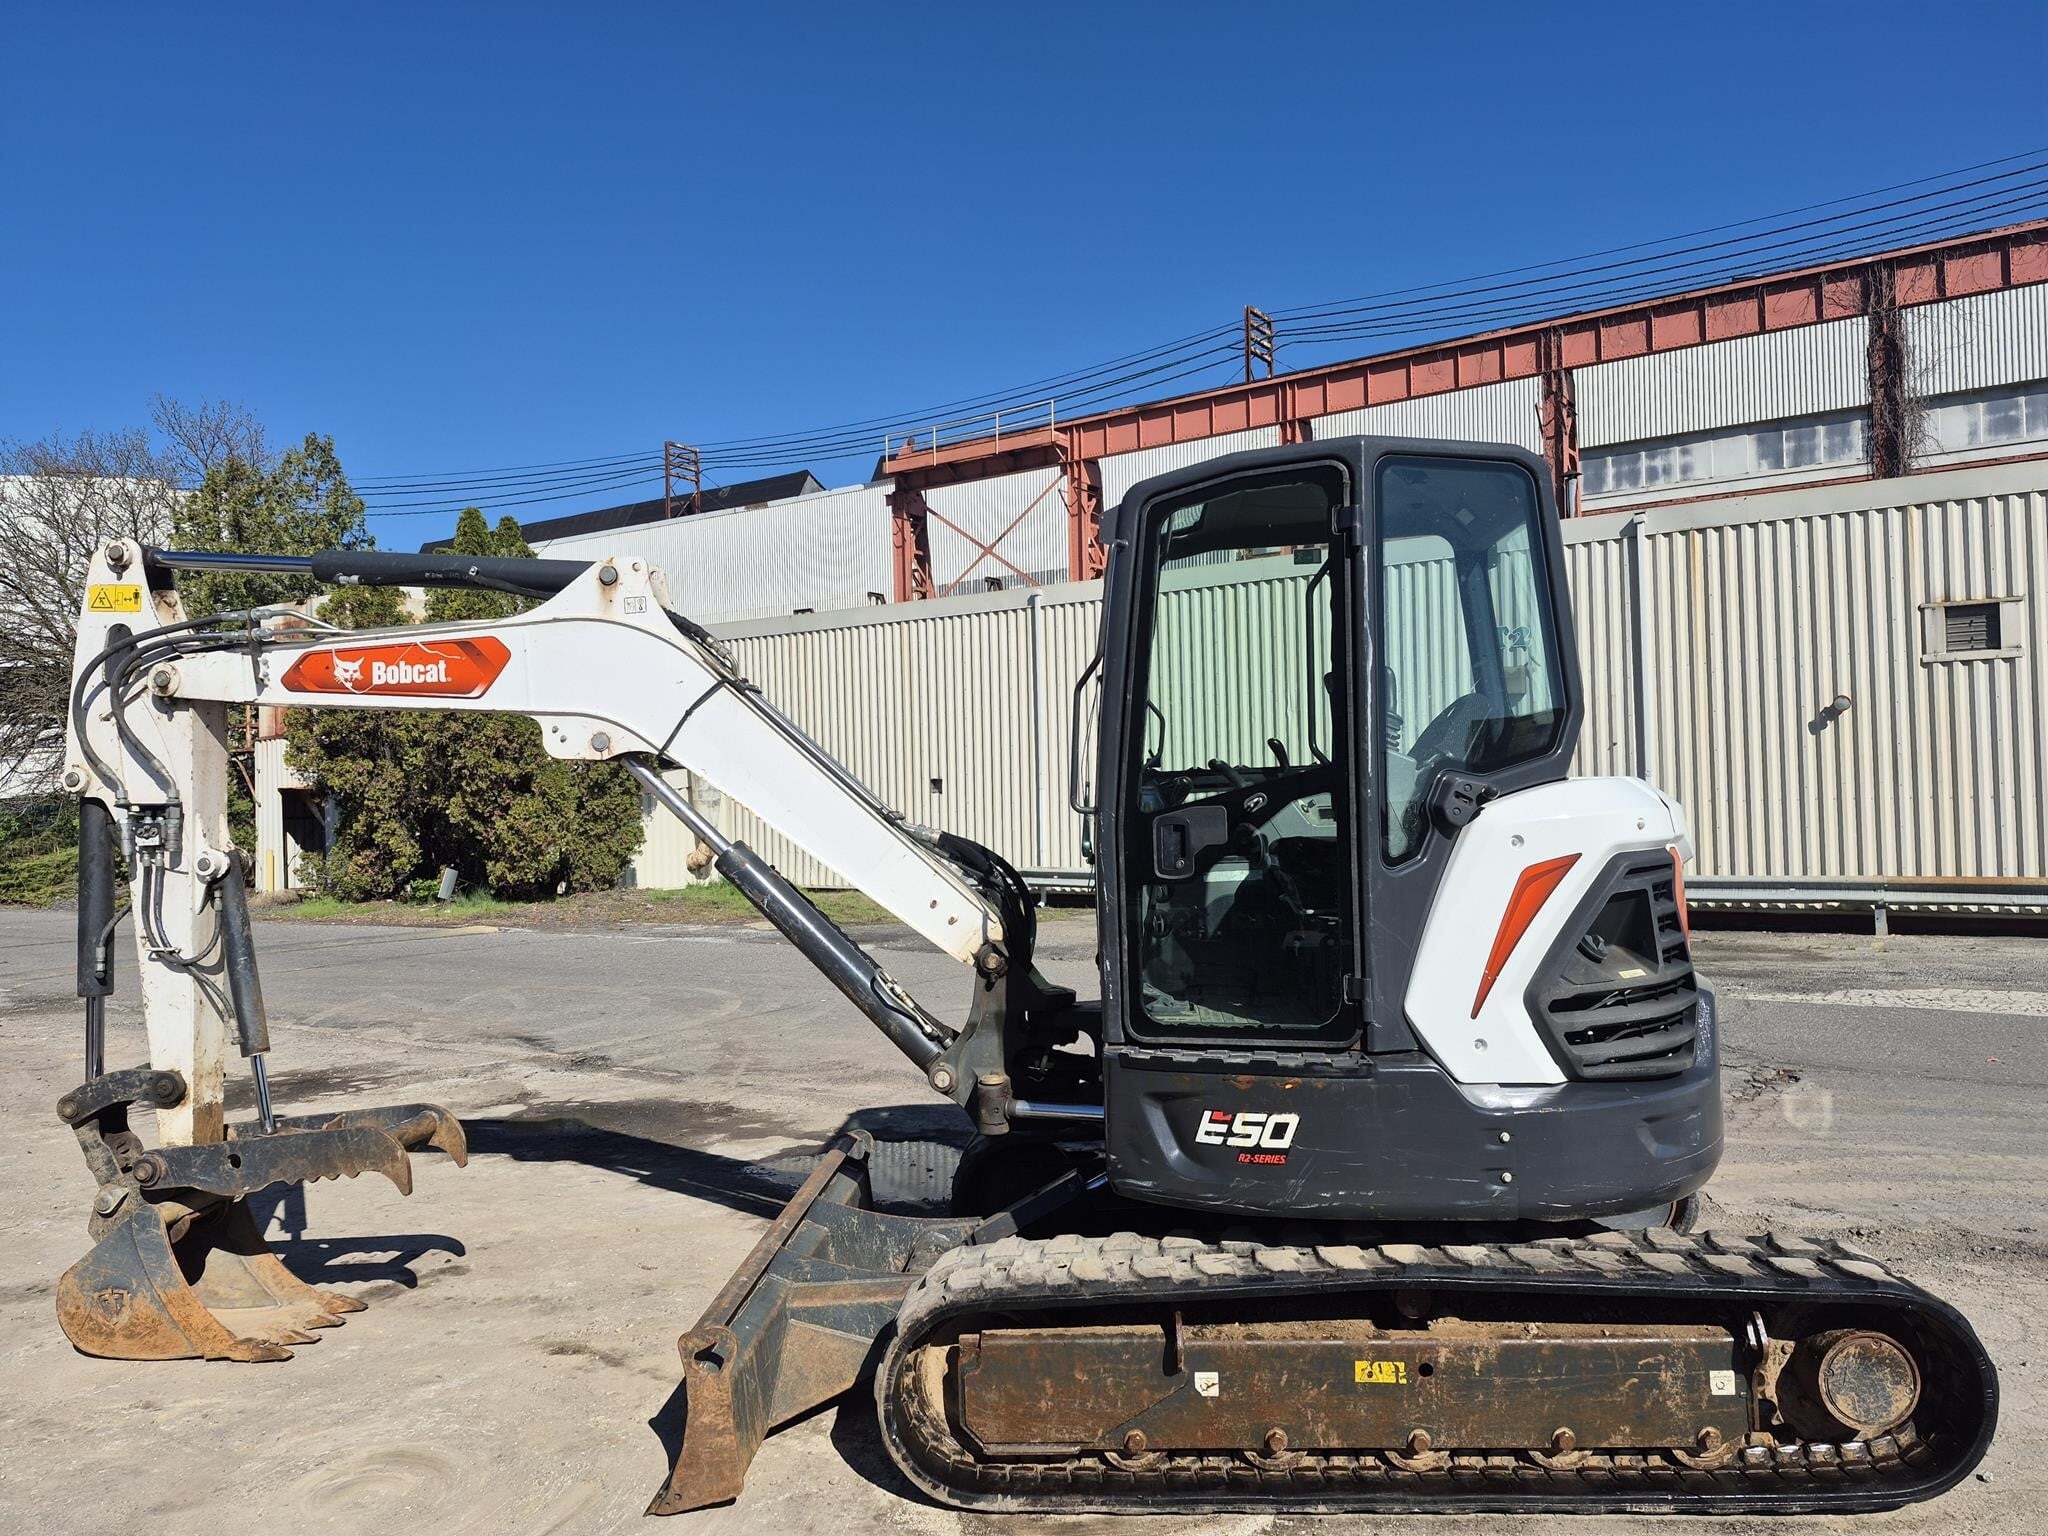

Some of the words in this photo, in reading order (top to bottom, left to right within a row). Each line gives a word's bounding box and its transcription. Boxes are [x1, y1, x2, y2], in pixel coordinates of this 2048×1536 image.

[372, 660, 447, 685] Bobcat
[1195, 1110, 1300, 1148] E50
[1238, 1153, 1287, 1164] R2-SERIES
